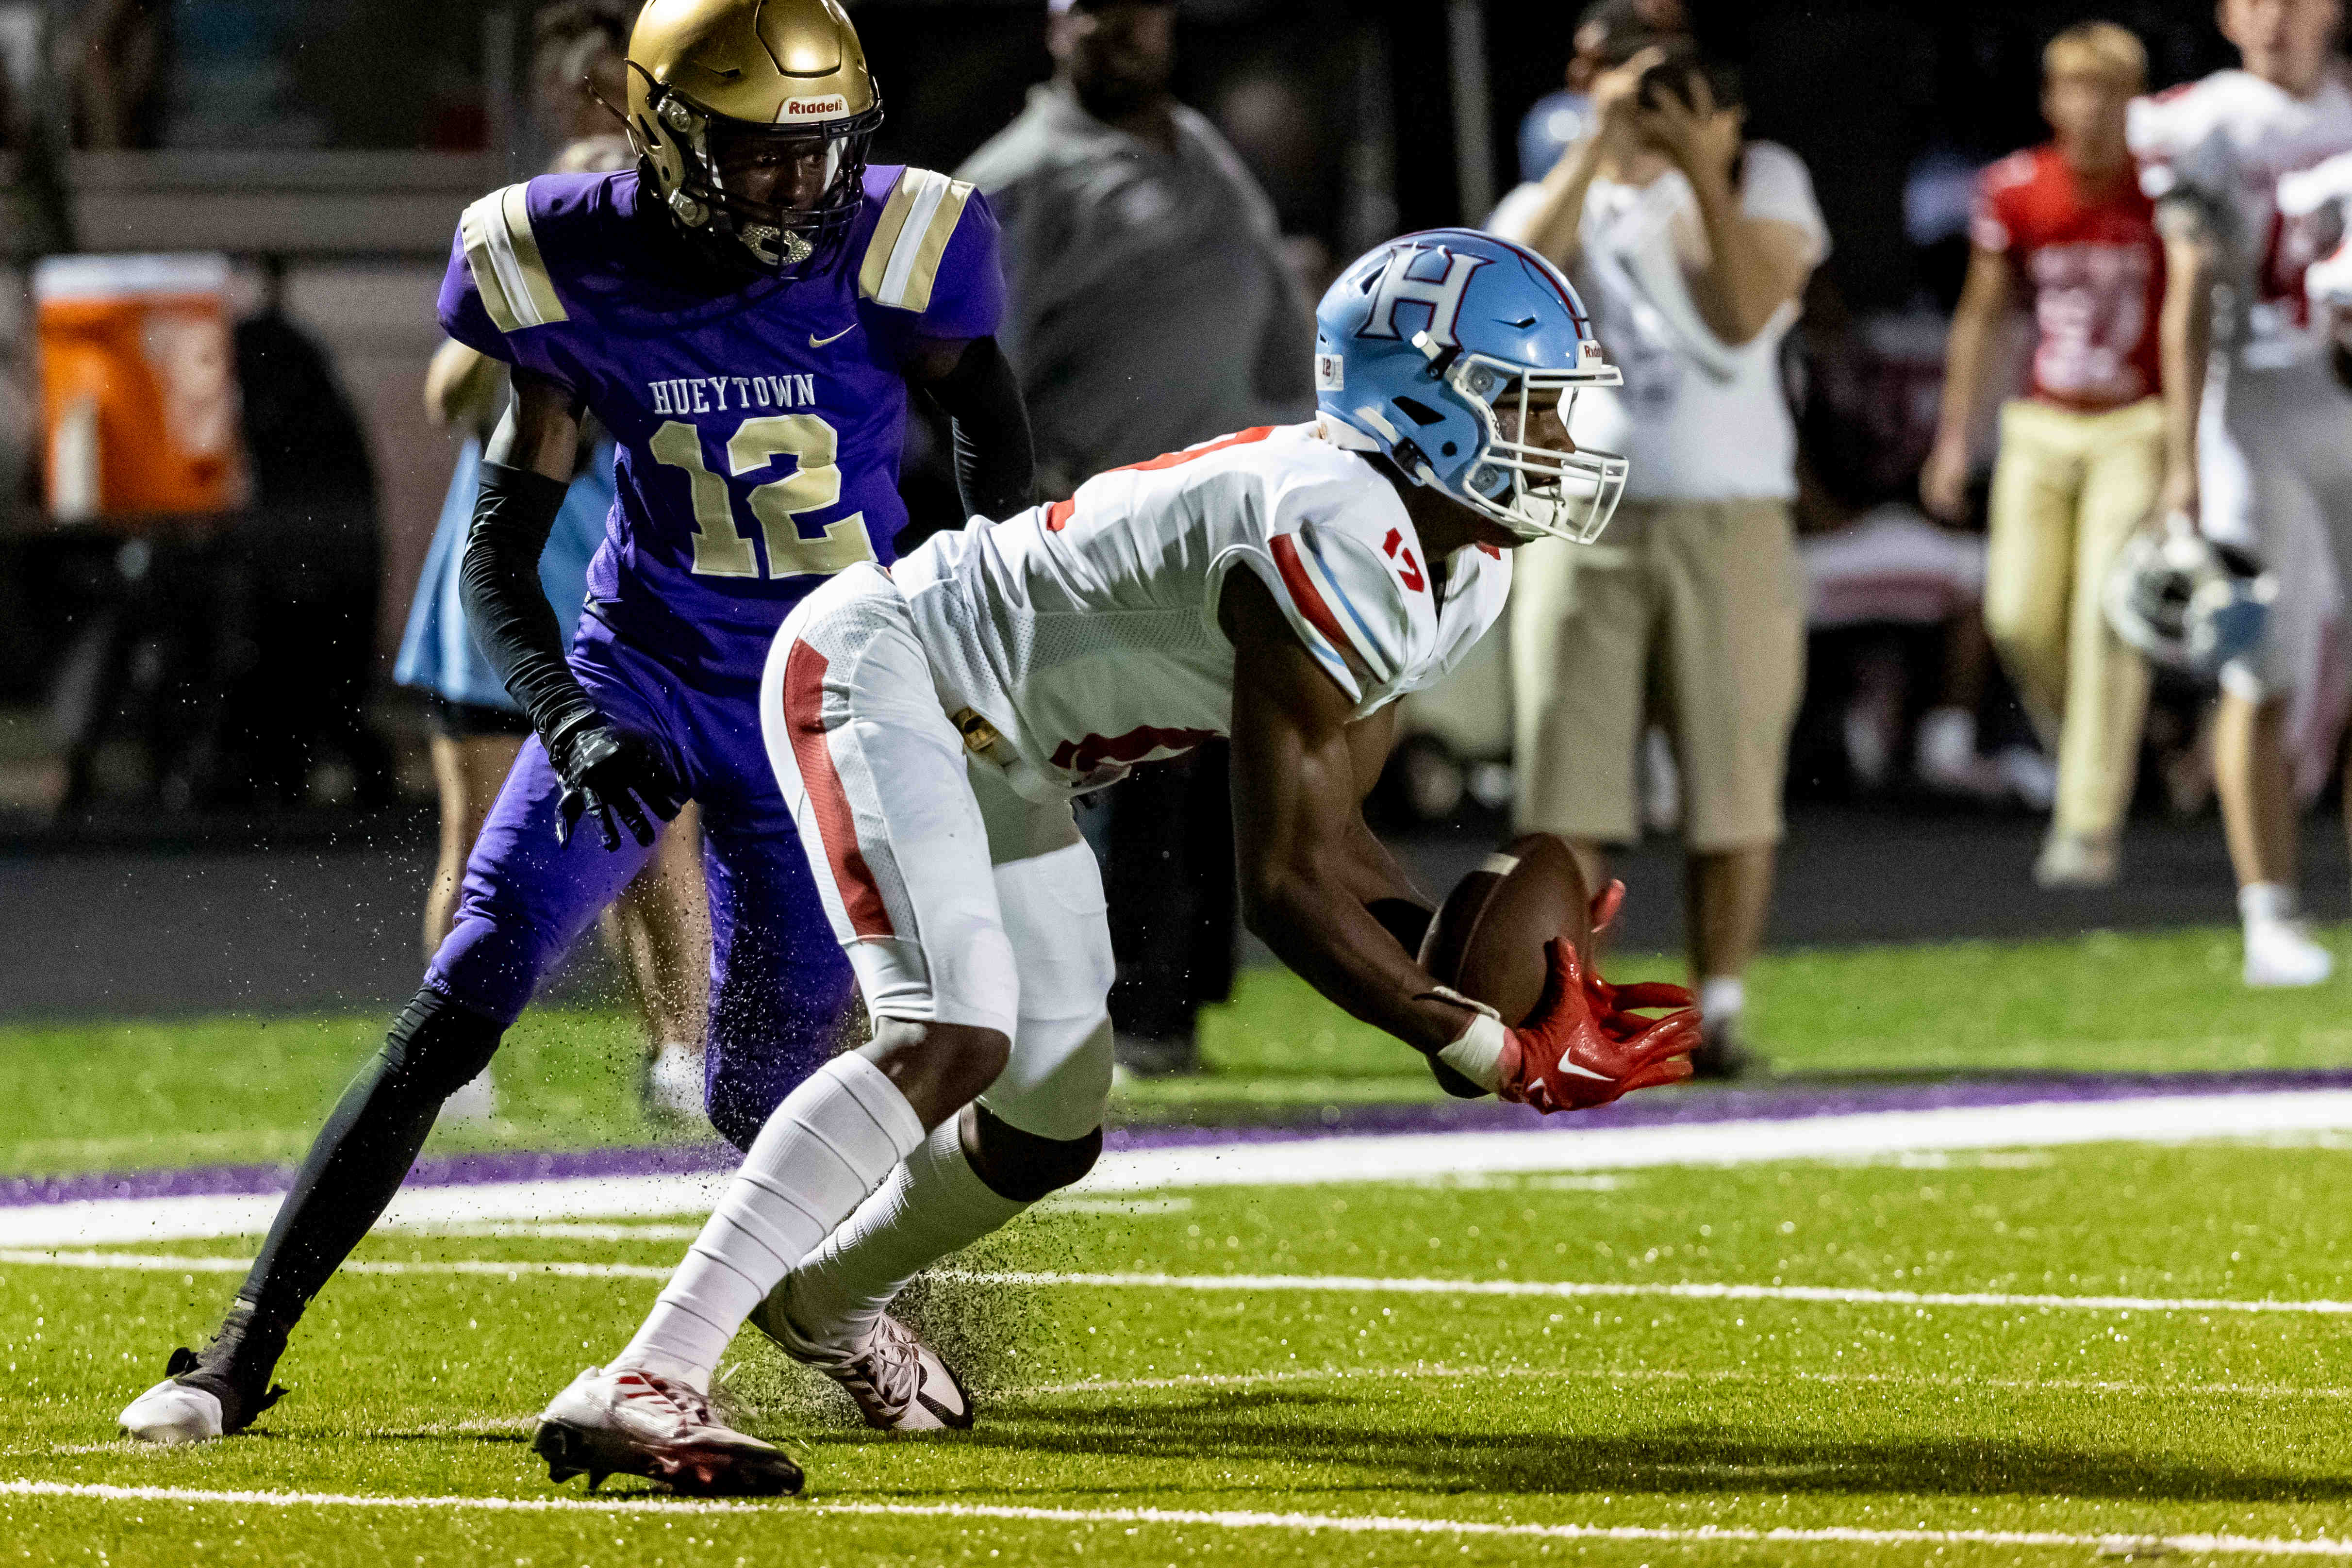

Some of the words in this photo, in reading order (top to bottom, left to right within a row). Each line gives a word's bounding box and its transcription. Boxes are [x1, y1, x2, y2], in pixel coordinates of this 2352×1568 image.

[1354, 244, 1496, 353] H
[648, 374, 816, 414] HUEYTOWN
[1323, 358, 1331, 377] 12
[649, 414, 879, 579] 12
